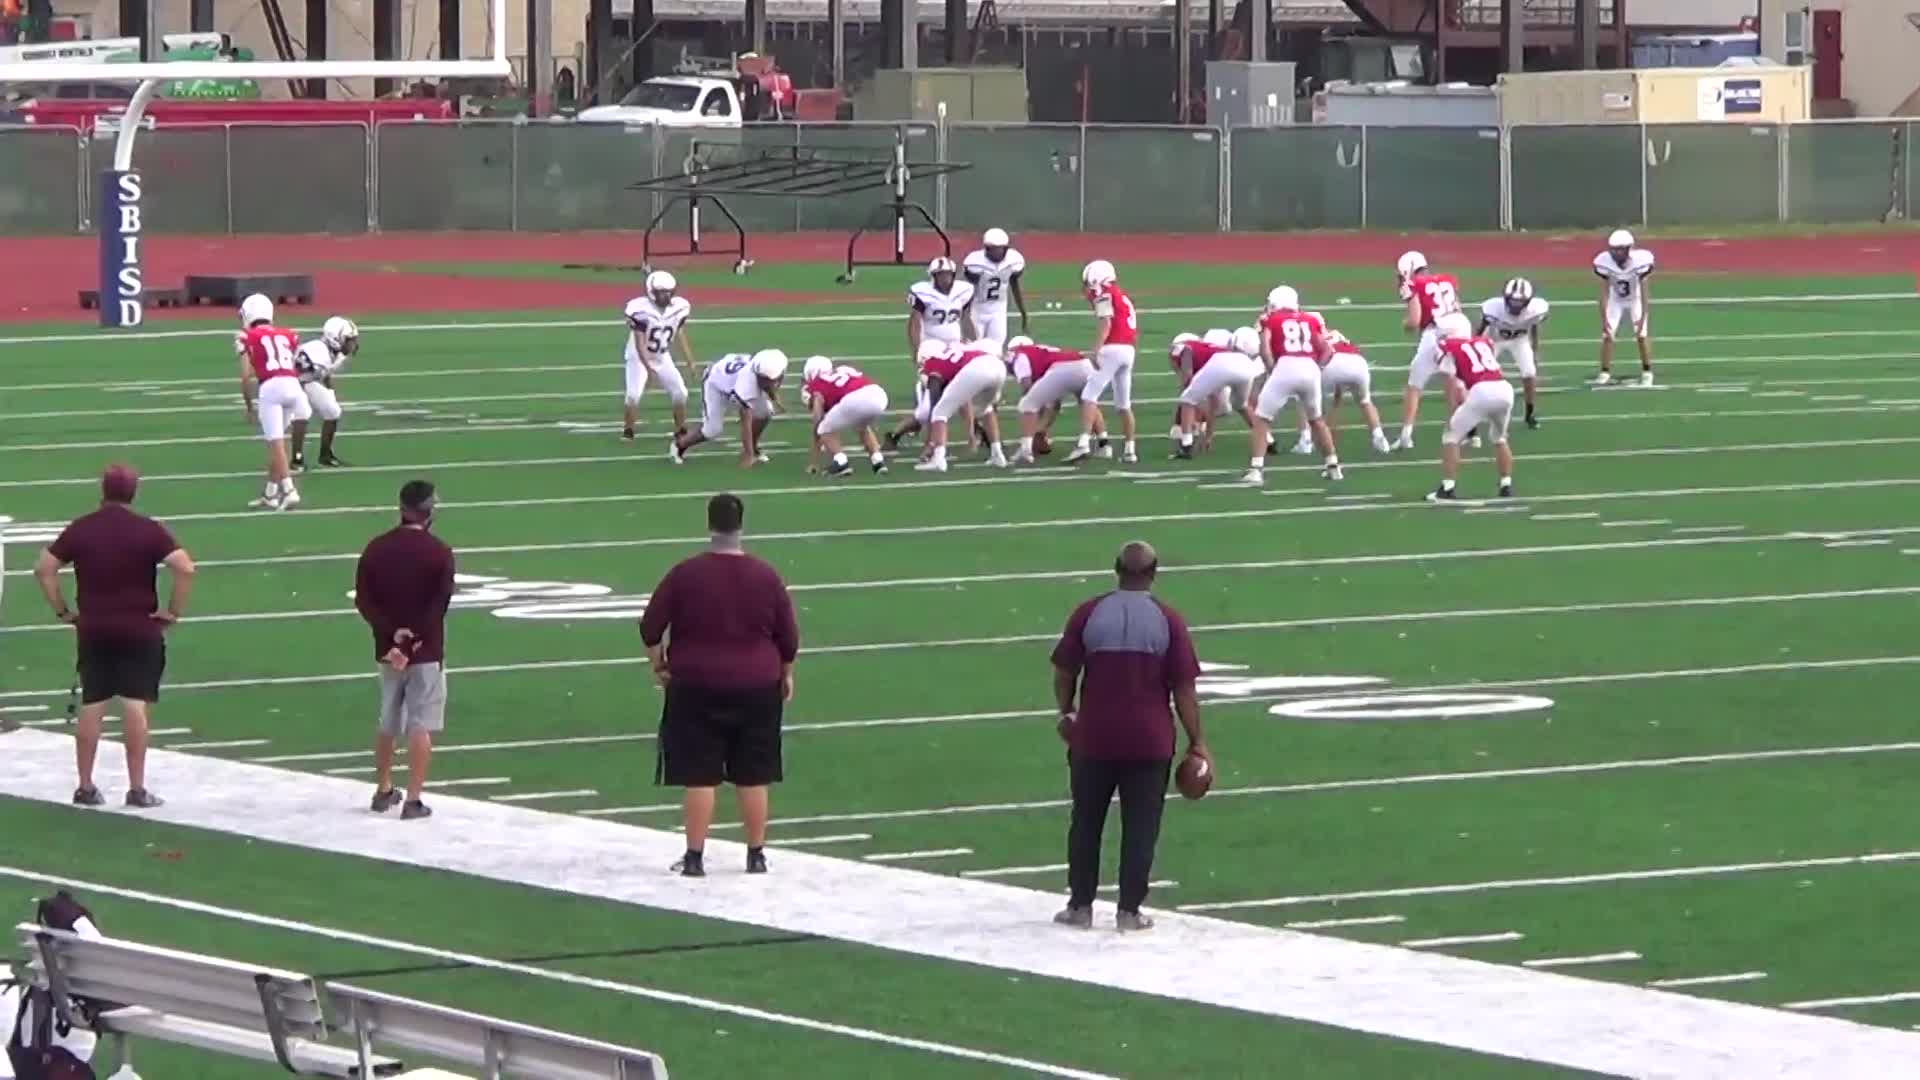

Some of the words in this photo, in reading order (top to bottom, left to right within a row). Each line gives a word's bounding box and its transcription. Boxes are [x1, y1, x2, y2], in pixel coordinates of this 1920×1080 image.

[118, 174, 142, 326] SBISD
[986, 278, 1001, 300] 2
[1616, 280, 1631, 298] 3
[260, 334, 295, 372] 16
[1281, 319, 1313, 353] 81
